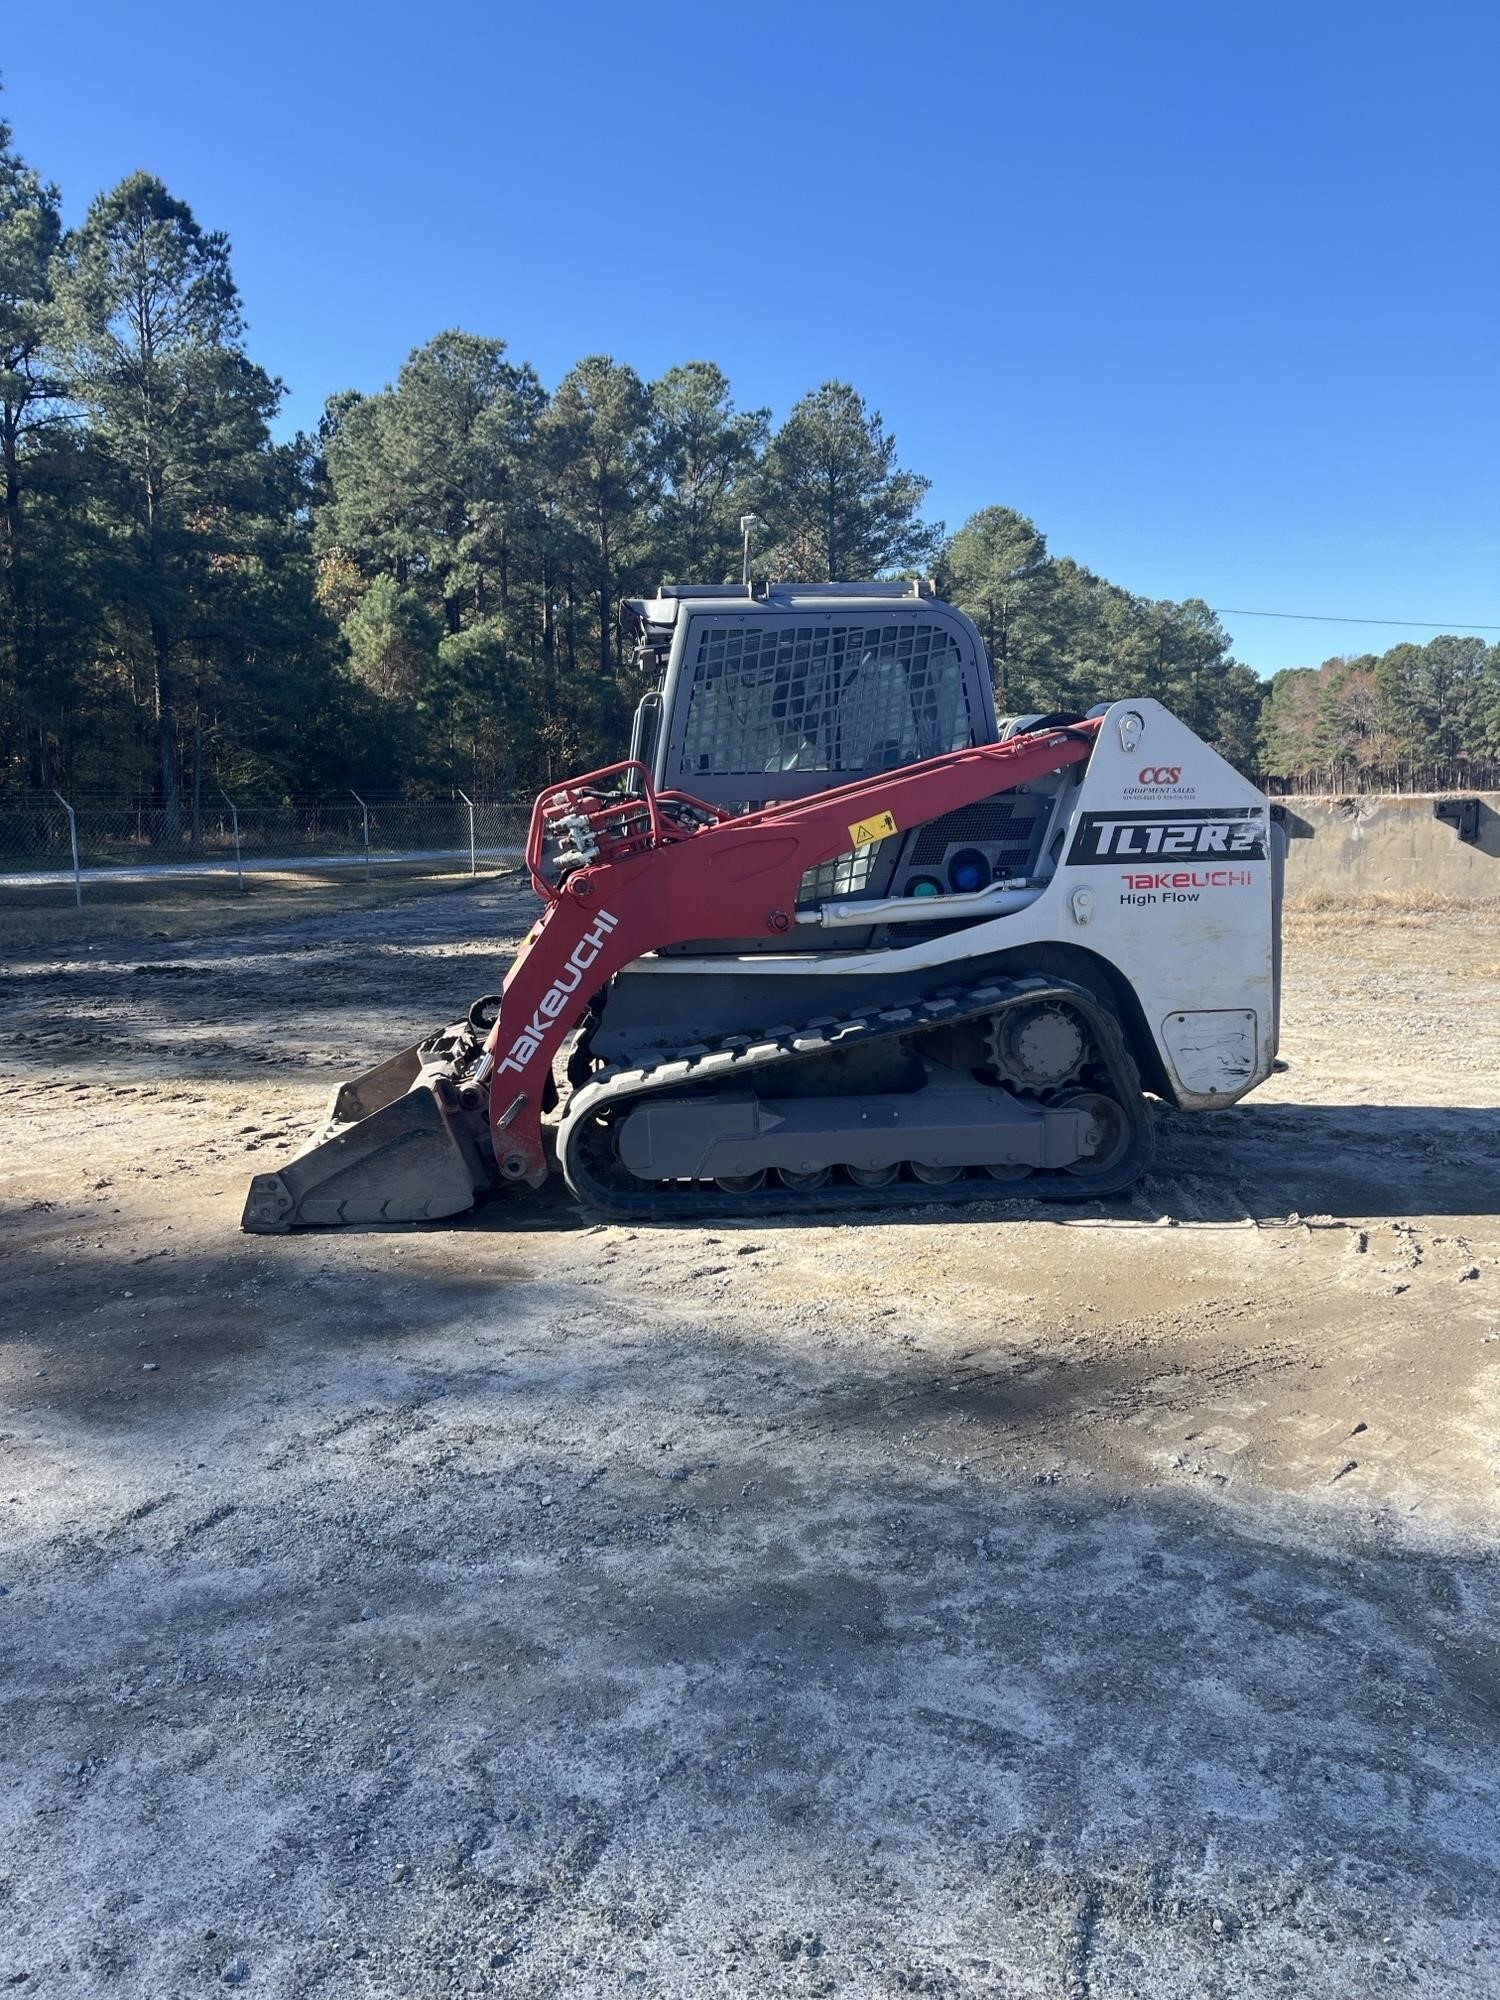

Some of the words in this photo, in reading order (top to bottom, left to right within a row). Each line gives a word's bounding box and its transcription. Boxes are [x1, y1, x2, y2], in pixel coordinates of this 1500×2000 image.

[1138, 766, 1182, 785] CCS
[1123, 787, 1171, 795] EQUIPMENT
[1092, 819, 1257, 855] TL12R2
[1120, 893, 1157, 907] High
[1162, 892, 1200, 904] Flow
